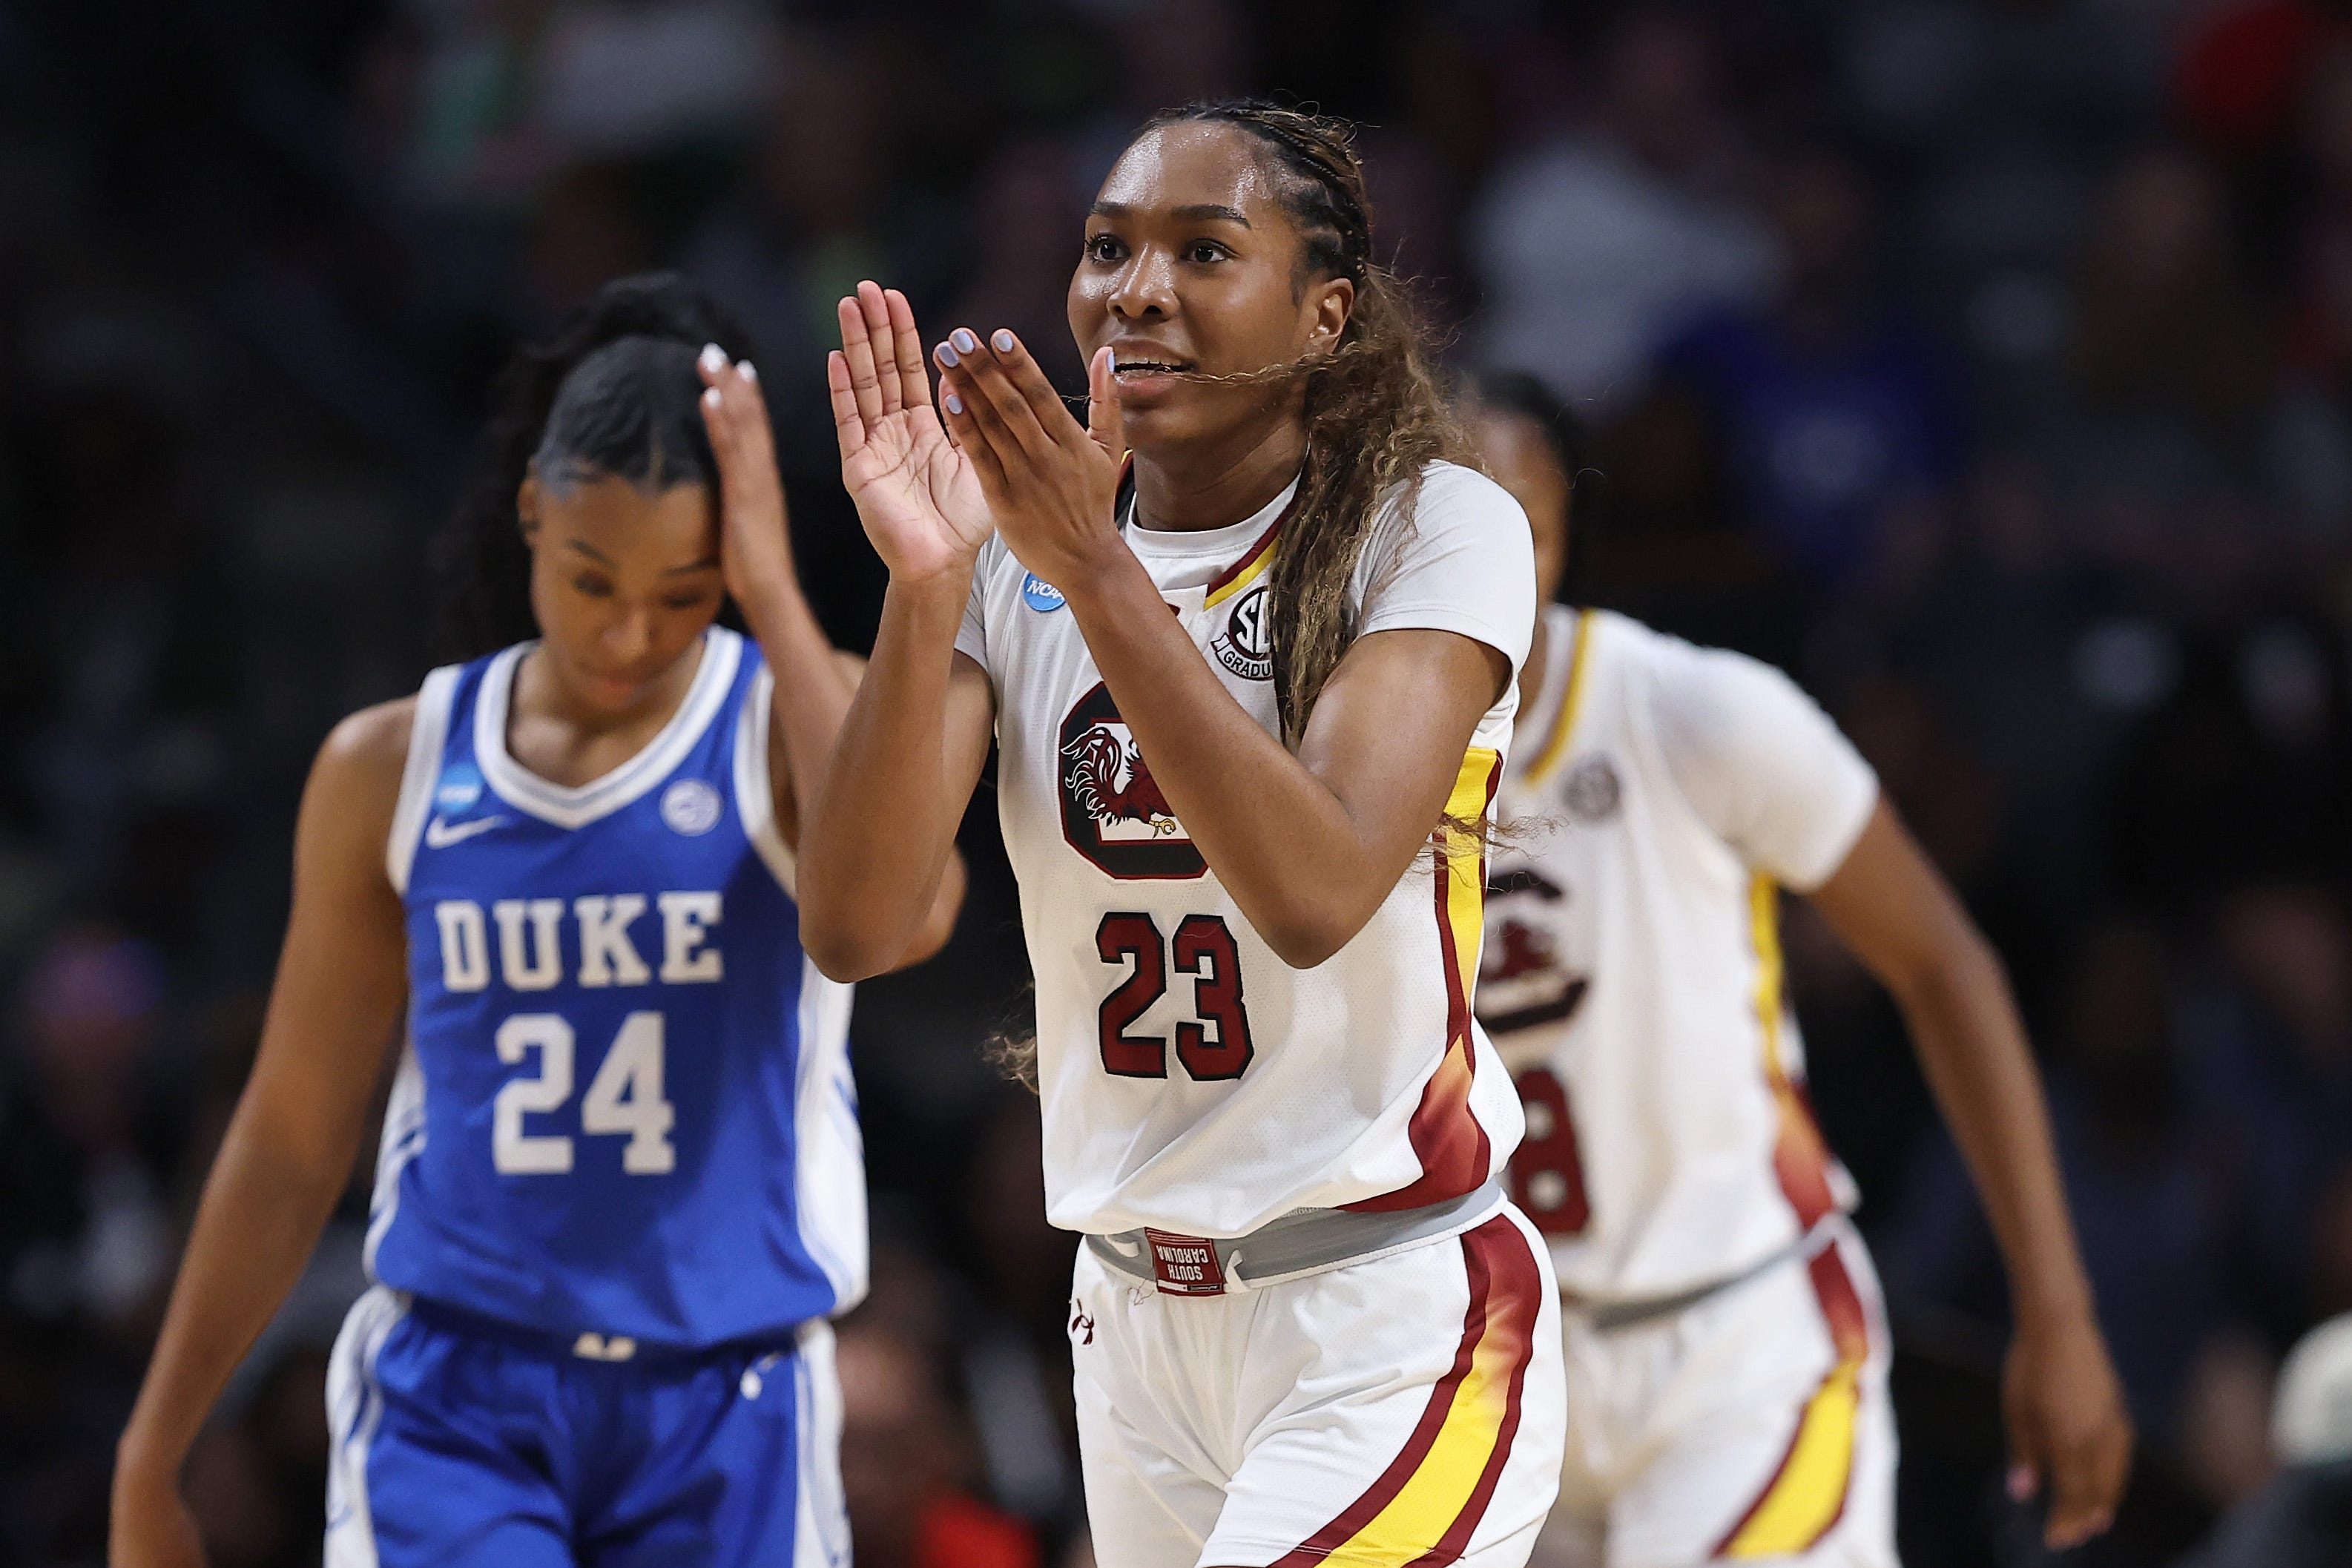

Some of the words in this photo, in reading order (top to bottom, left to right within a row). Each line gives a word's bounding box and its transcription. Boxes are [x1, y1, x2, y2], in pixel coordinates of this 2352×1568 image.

[1223, 650, 1271, 677] GRADU
[435, 892, 724, 992] DUKE
[1096, 912, 1254, 1081] 23
[493, 1010, 675, 1175] 24
[1156, 1245, 1209, 1264] CAROLINA
[1167, 1263, 1203, 1281] SOUTH
